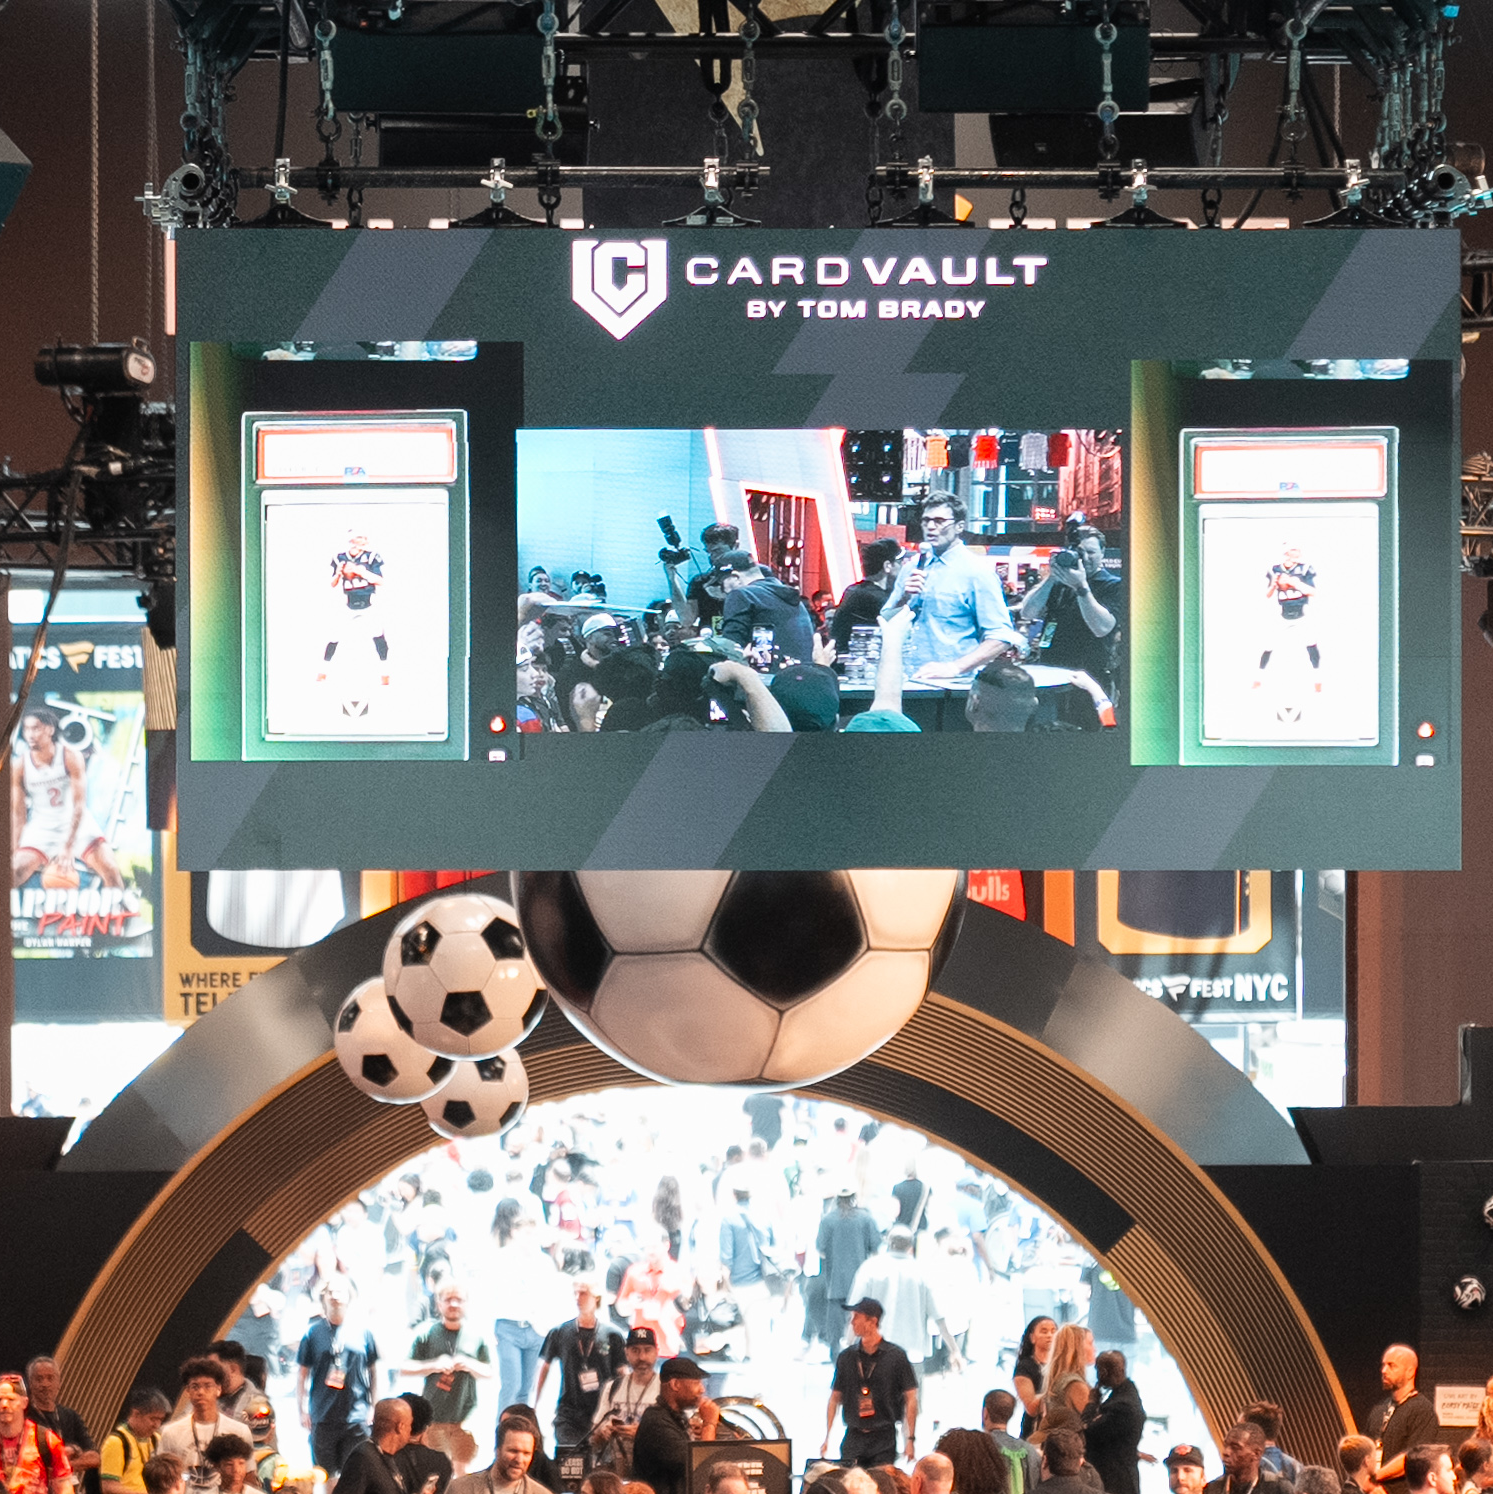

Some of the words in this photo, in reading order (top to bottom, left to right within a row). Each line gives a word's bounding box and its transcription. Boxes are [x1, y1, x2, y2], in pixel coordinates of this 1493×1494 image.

[747, 299, 787, 319] BY
[796, 299, 867, 319] TOM
[877, 299, 986, 319] BRADY
[37, 911, 141, 937] PAINT
[179, 972, 235, 988] WHERE
[1190, 981, 1233, 998] FEST
[1233, 973, 1289, 1002] NYC
